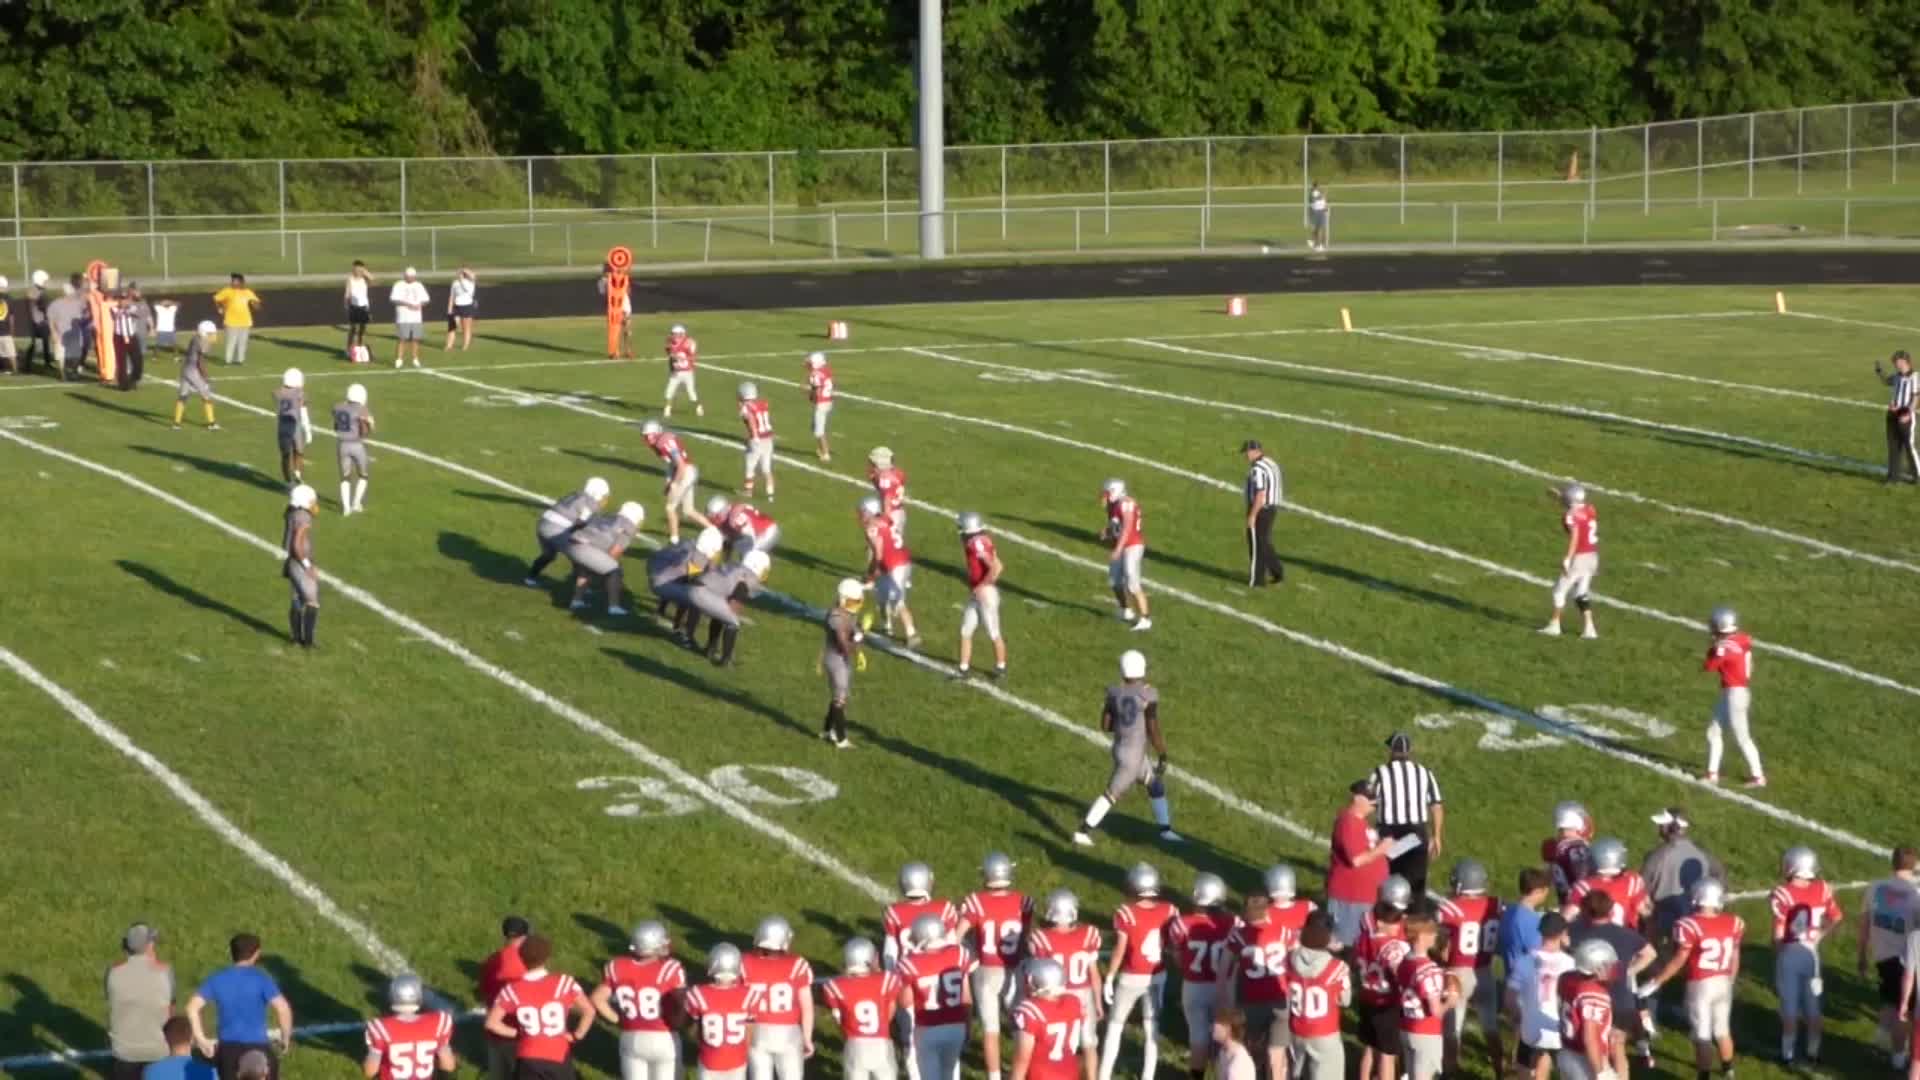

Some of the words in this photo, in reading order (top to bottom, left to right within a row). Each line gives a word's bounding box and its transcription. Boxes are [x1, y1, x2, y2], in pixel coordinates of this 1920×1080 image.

[576, 764, 839, 818] 30
[1241, 943, 1287, 979] 32
[1698, 938, 1734, 970] 21
[615, 985, 662, 1020] 68
[917, 969, 962, 1011] 75
[516, 1001, 566, 1037] 99
[701, 1012, 749, 1048] 85
[854, 1001, 880, 1034] 9
[389, 1040, 438, 1080] 55
